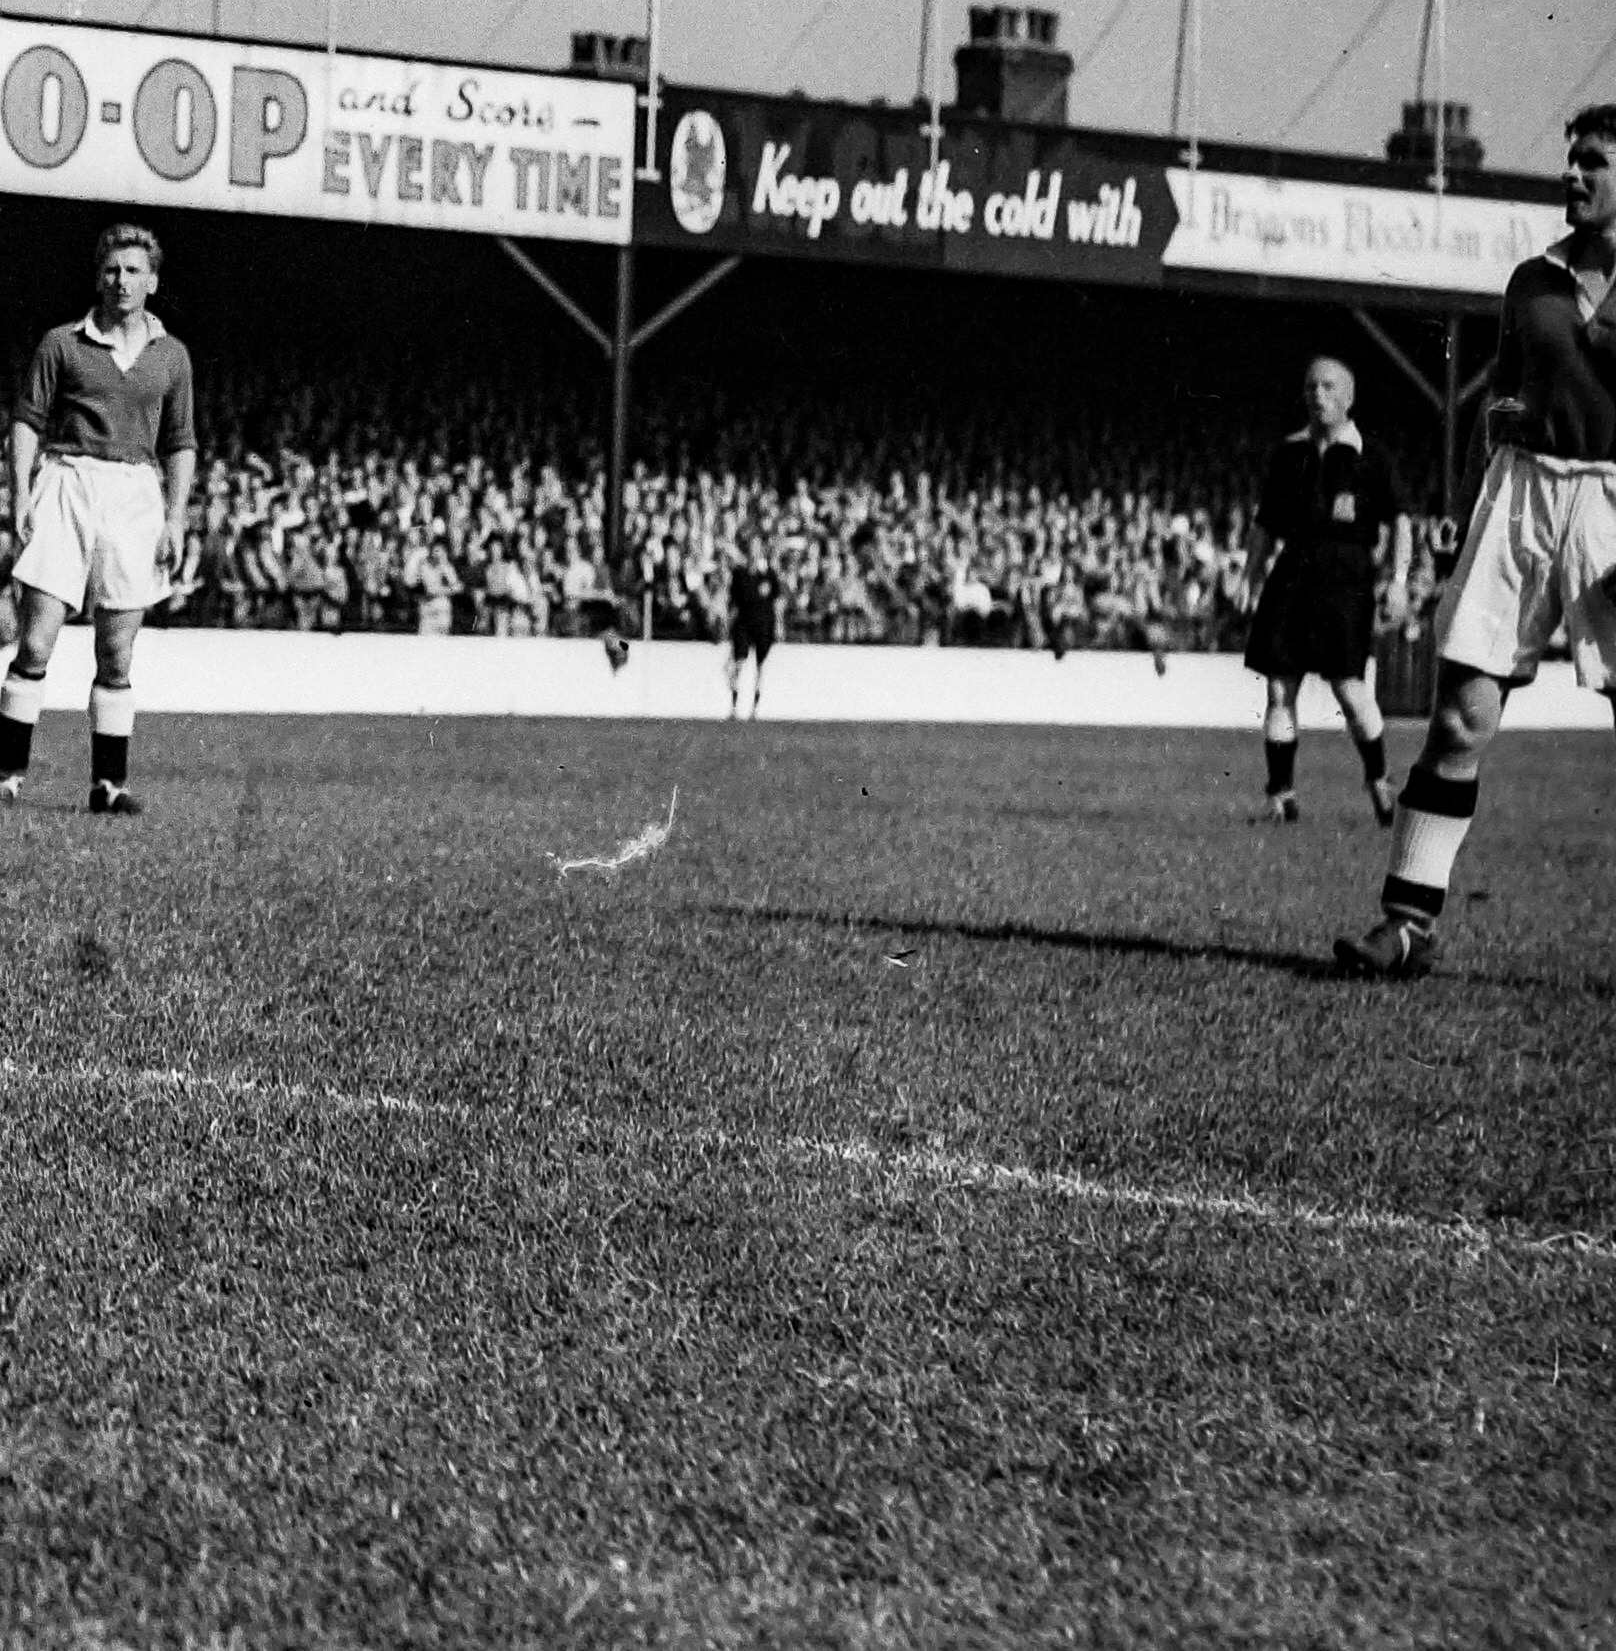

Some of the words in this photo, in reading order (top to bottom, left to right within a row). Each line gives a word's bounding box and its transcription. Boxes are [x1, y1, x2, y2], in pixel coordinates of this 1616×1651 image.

[338, 80, 420, 118] and
[321, 129, 496, 208] EVERY
[508, 146, 622, 218] TIME
[751, 141, 841, 239] Keep
[850, 168, 909, 227] out
[915, 160, 974, 234] the
[984, 168, 1062, 240] cold
[1068, 177, 1143, 248] with
